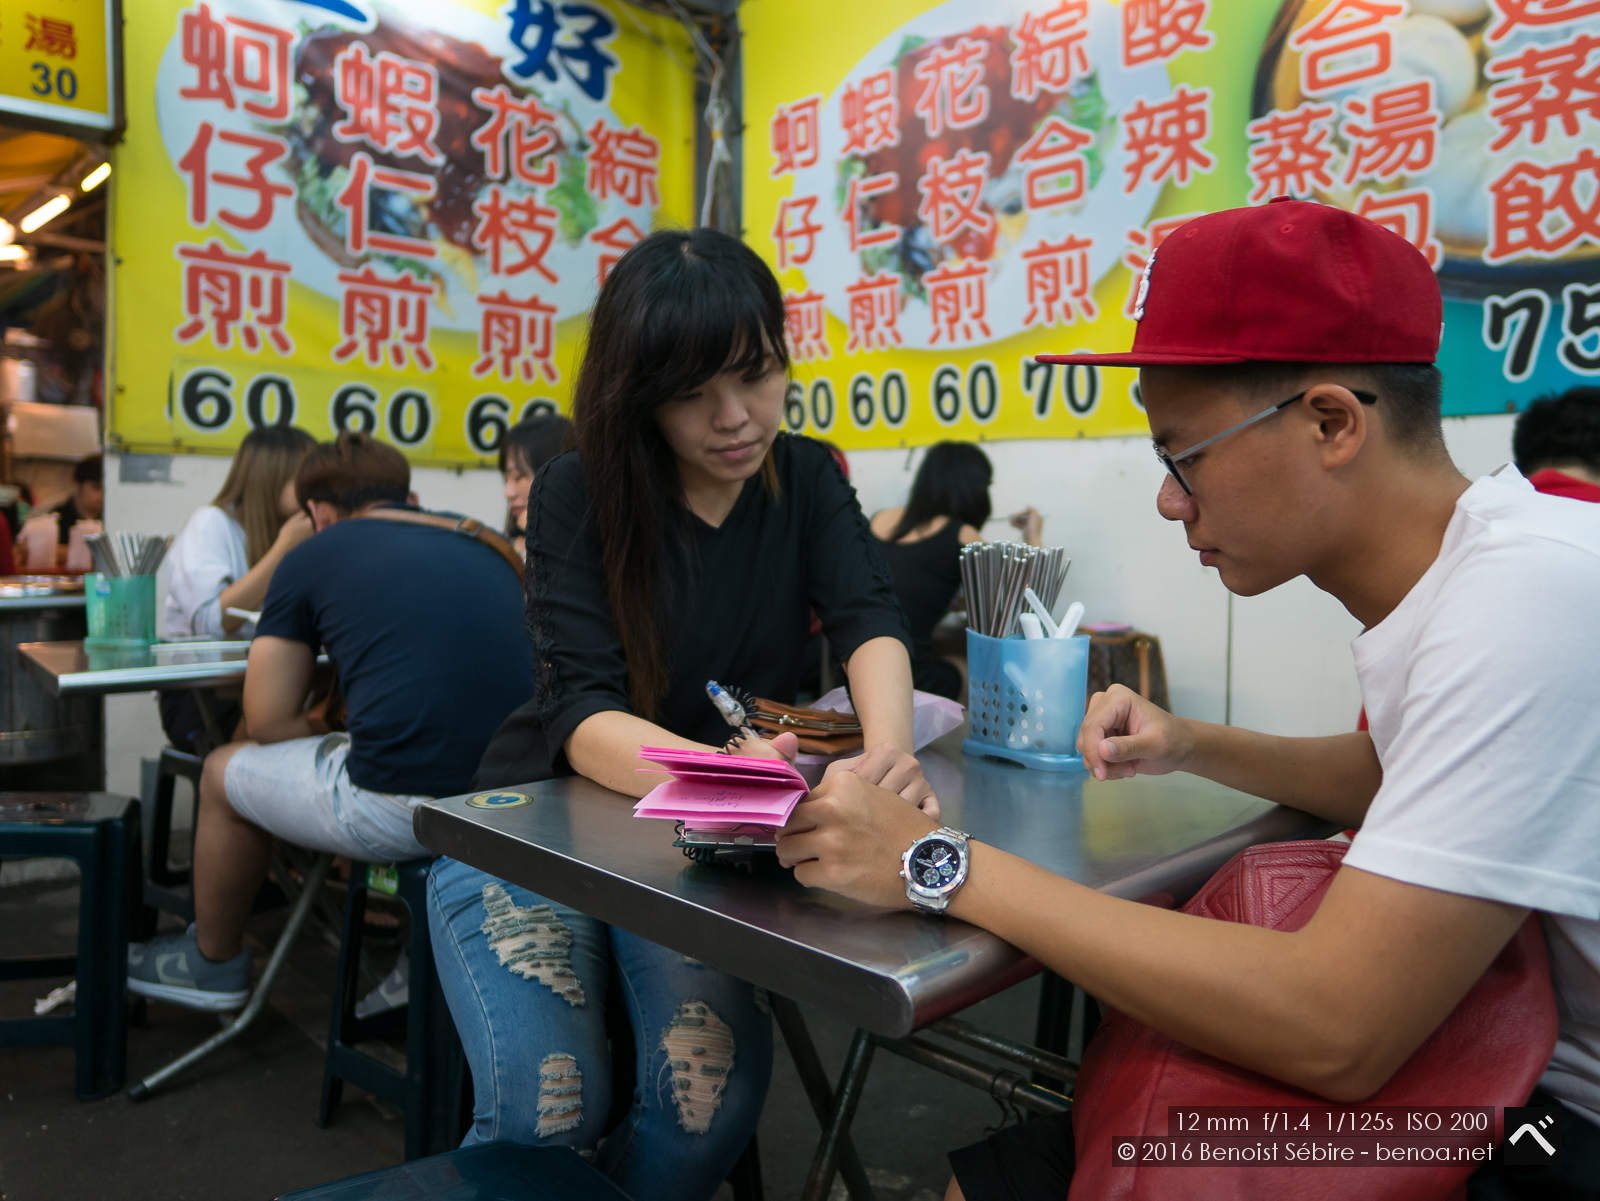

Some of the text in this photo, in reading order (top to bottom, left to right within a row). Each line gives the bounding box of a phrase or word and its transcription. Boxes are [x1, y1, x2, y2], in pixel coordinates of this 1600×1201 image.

[24, 12, 77, 60] 湯
[31, 61, 78, 101] 30
[508, 0, 618, 100] 好
[1015, 0, 1096, 325] 綜合煎
[178, 4, 295, 353] 蚵仔煎
[335, 47, 440, 369] 蝦仁煎
[473, 87, 559, 382] 花枝煎
[772, 98, 828, 358] 蚵仔煎
[840, 70, 900, 351] 蝦仁煎
[919, 40, 991, 344] 花枝煎
[181, 369, 296, 430] 60
[332, 385, 431, 444] 60
[785, 380, 834, 431] 60
[850, 373, 906, 427] 60
[934, 364, 997, 422] 60
[1024, 356, 1098, 416] 70
[1489, 286, 1600, 377] 75
